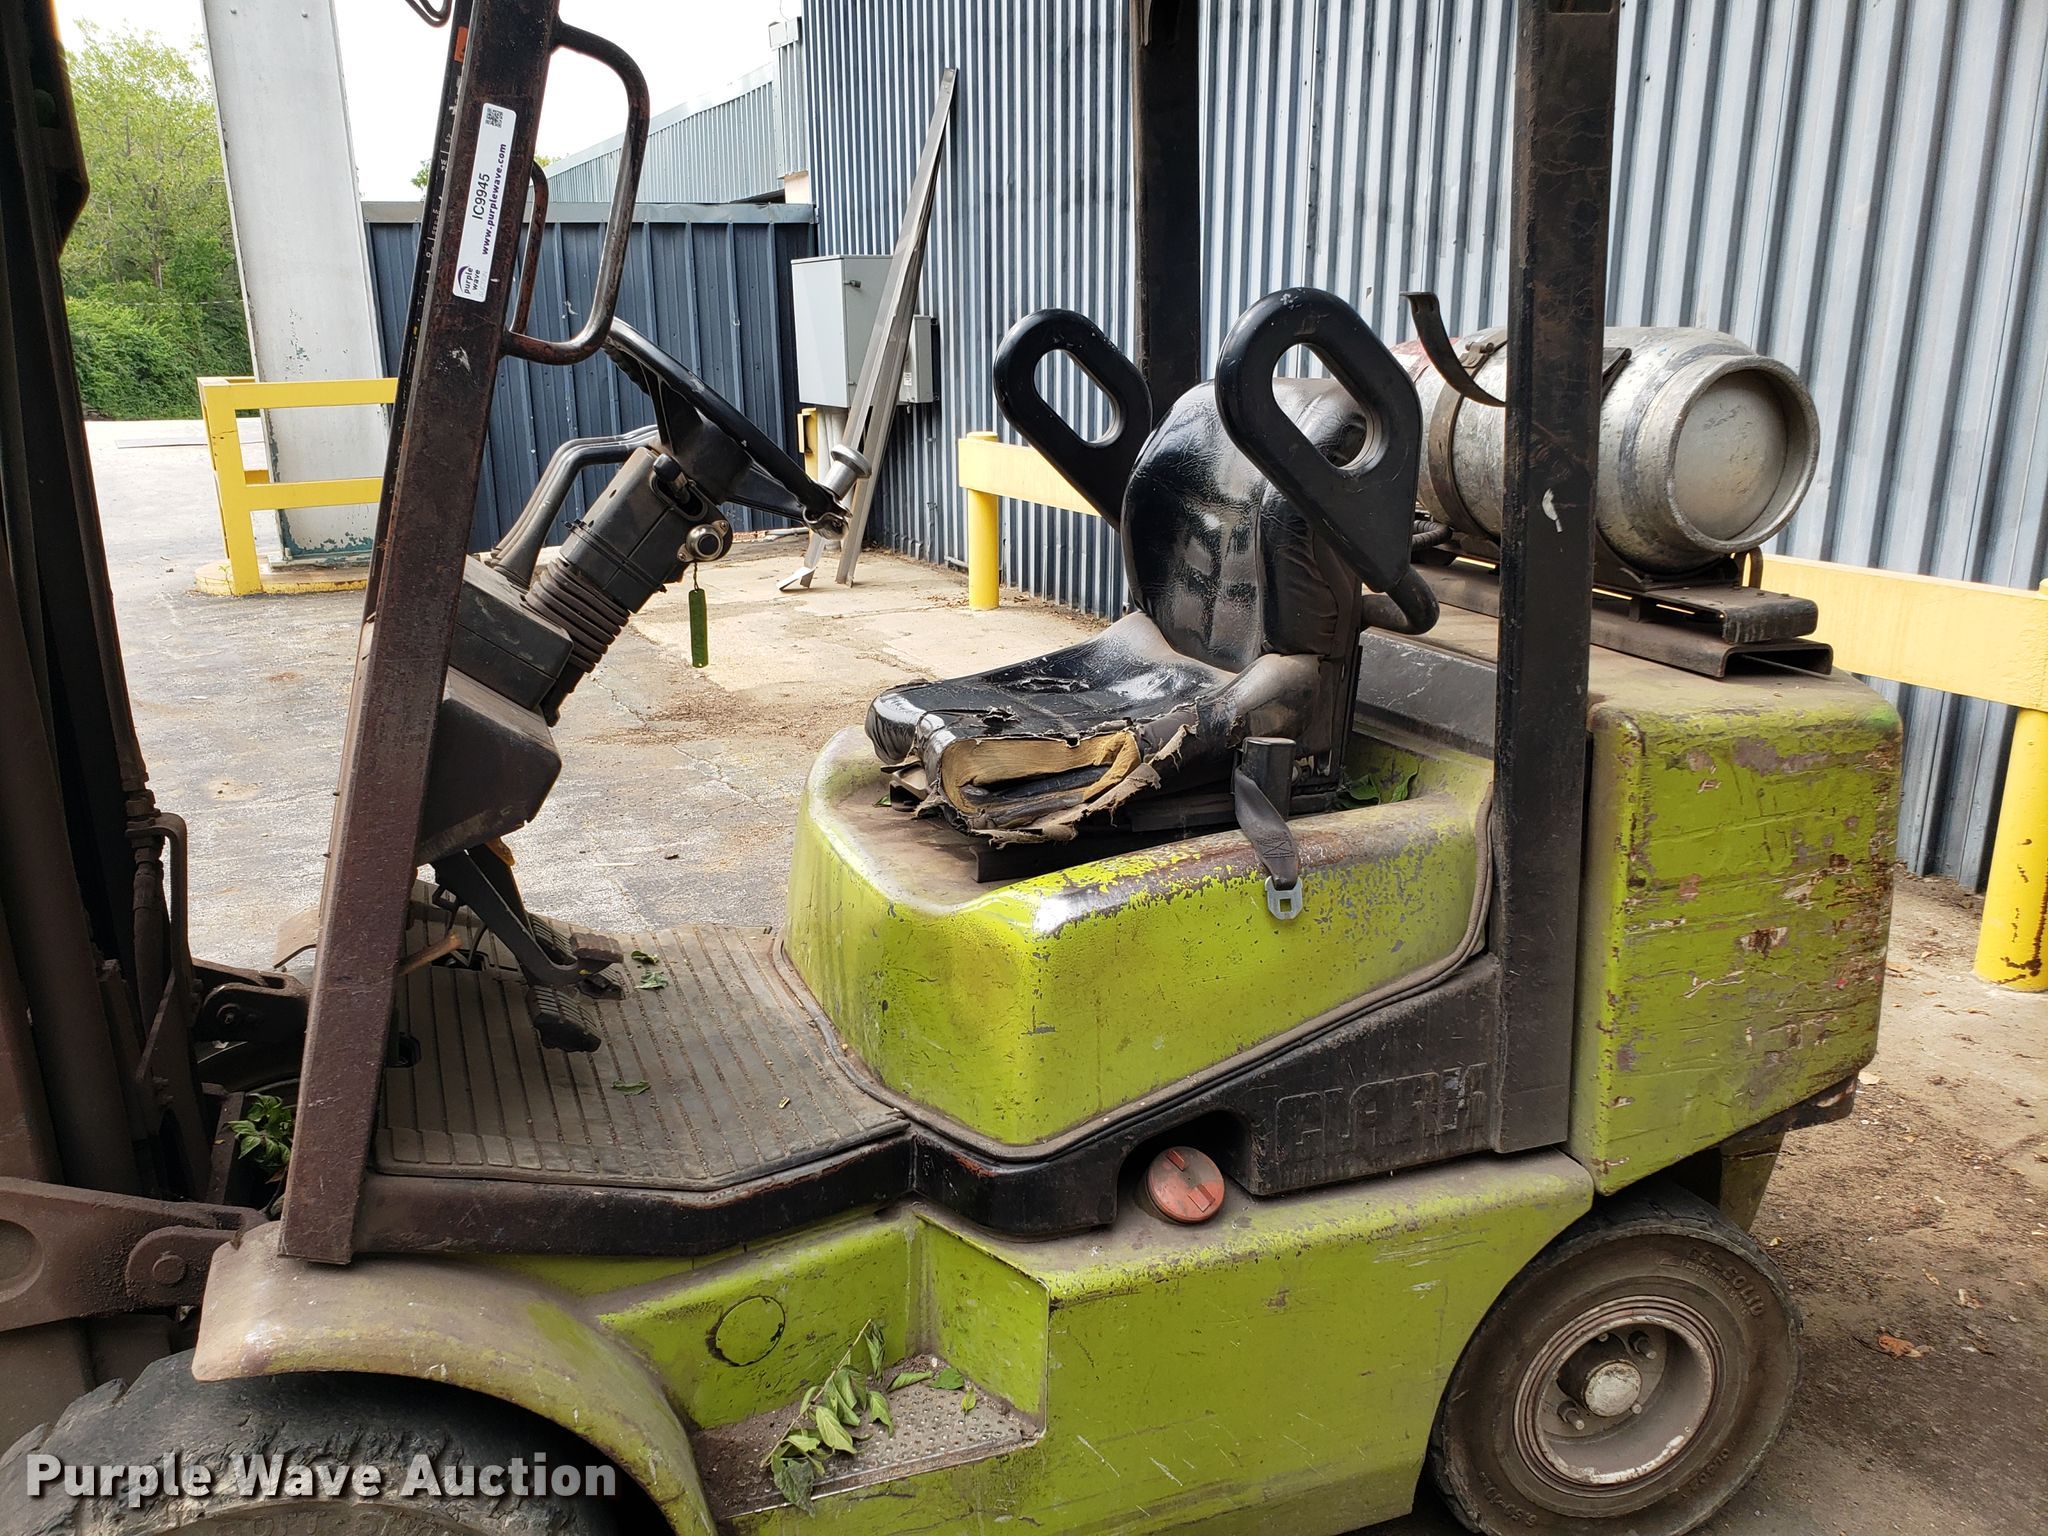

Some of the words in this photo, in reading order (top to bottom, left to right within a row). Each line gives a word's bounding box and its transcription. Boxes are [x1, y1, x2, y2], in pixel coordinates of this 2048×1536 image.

[471, 172, 490, 220] IC9945
[482, 143, 507, 255] www.purplewave.com
[464, 267, 474, 295] purple
[472, 269, 481, 291] wave
